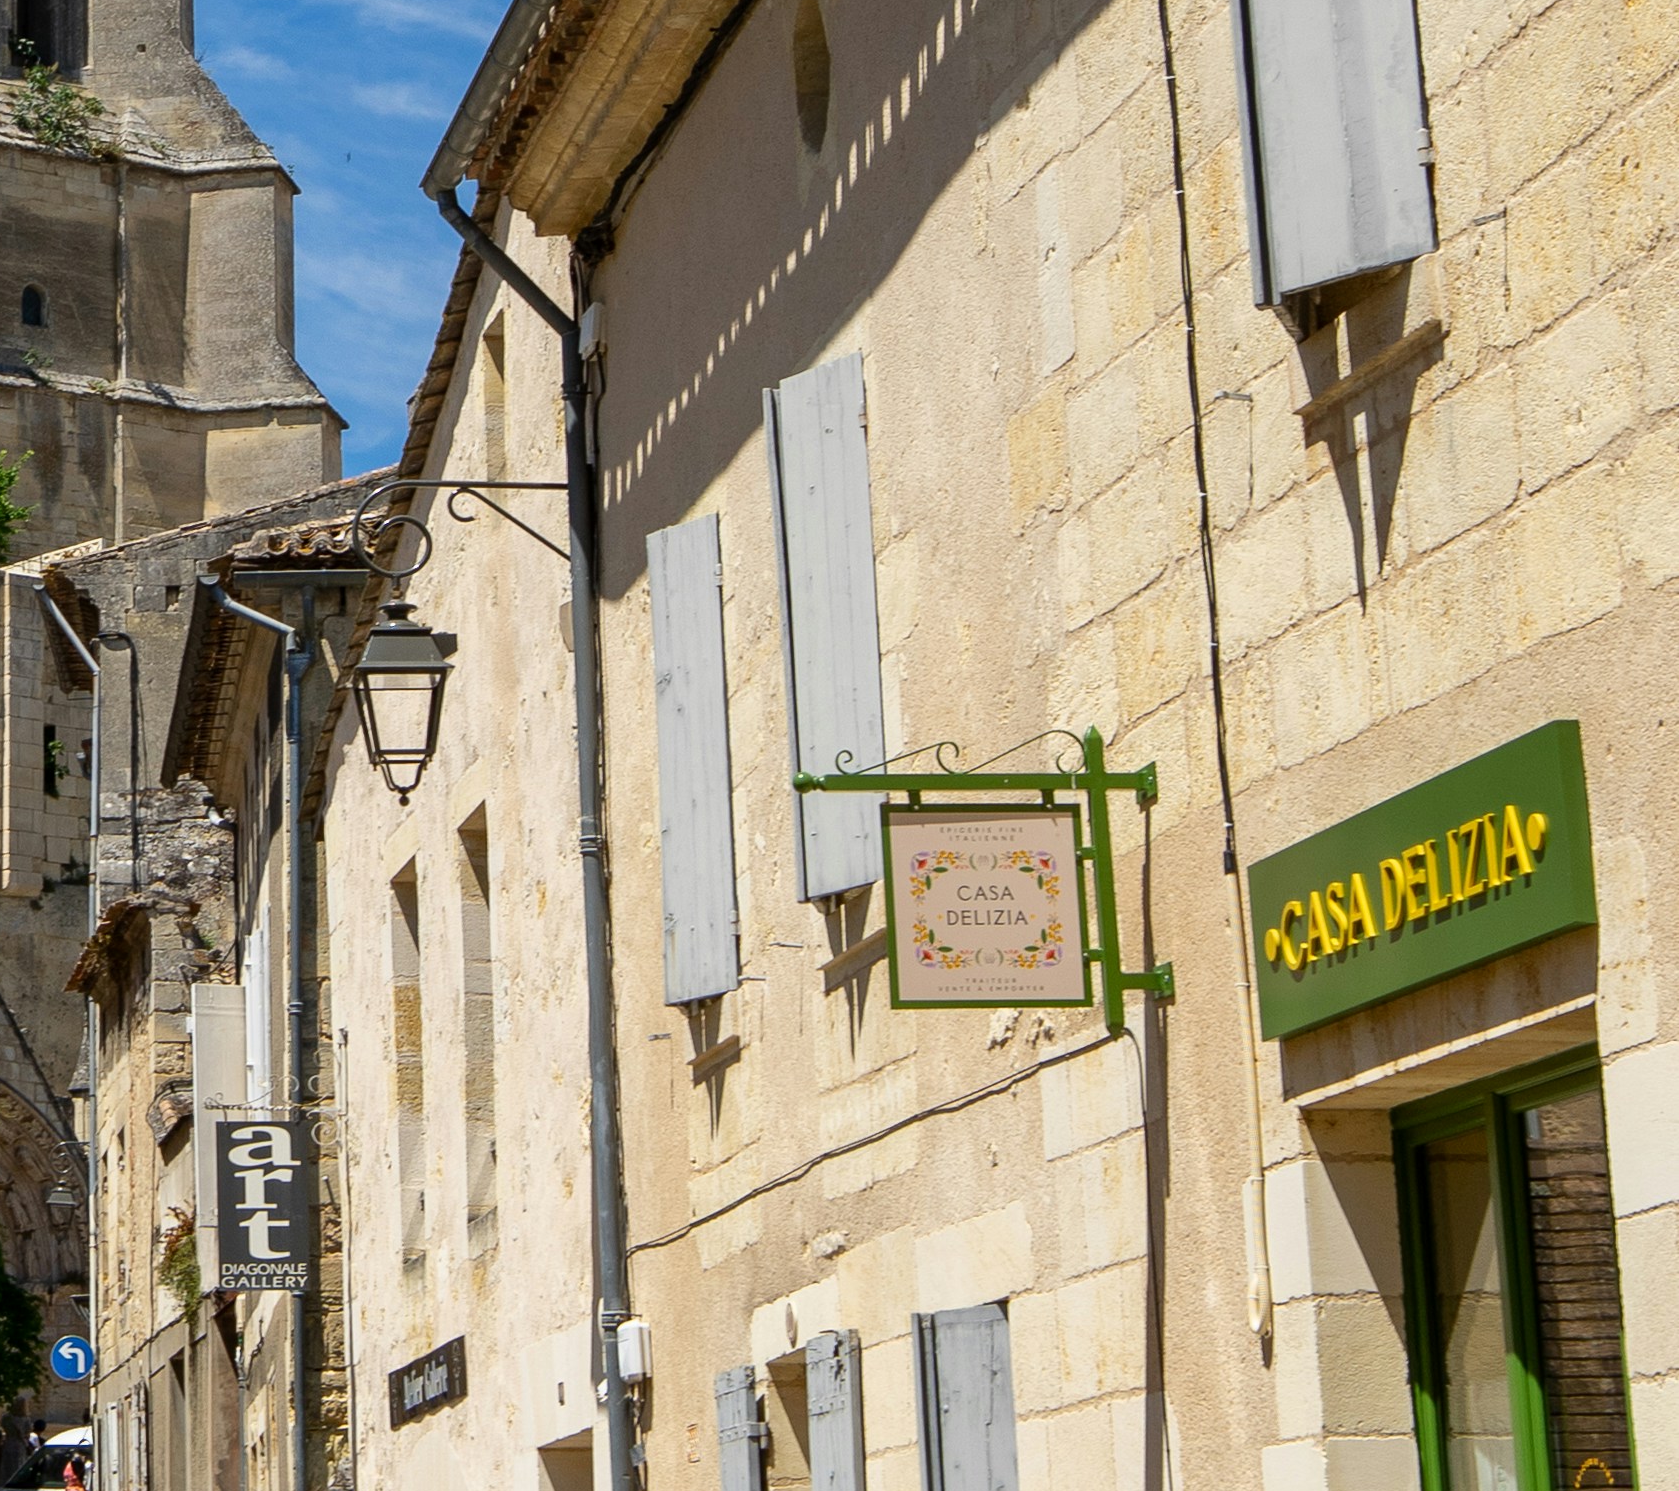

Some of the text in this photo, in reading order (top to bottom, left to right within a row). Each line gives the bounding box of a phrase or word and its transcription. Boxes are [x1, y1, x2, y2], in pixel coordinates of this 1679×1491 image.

[948, 834, 1016, 842] ITALIENNE
[956, 885, 1015, 901] CASA
[1281, 805, 1535, 970] CASA DELIZIA
[946, 909, 1029, 926] DELIZIA
[228, 1125, 302, 1260] art
[221, 1263, 308, 1276] DIAGONALE
[221, 1276, 308, 1289] GALLERY
